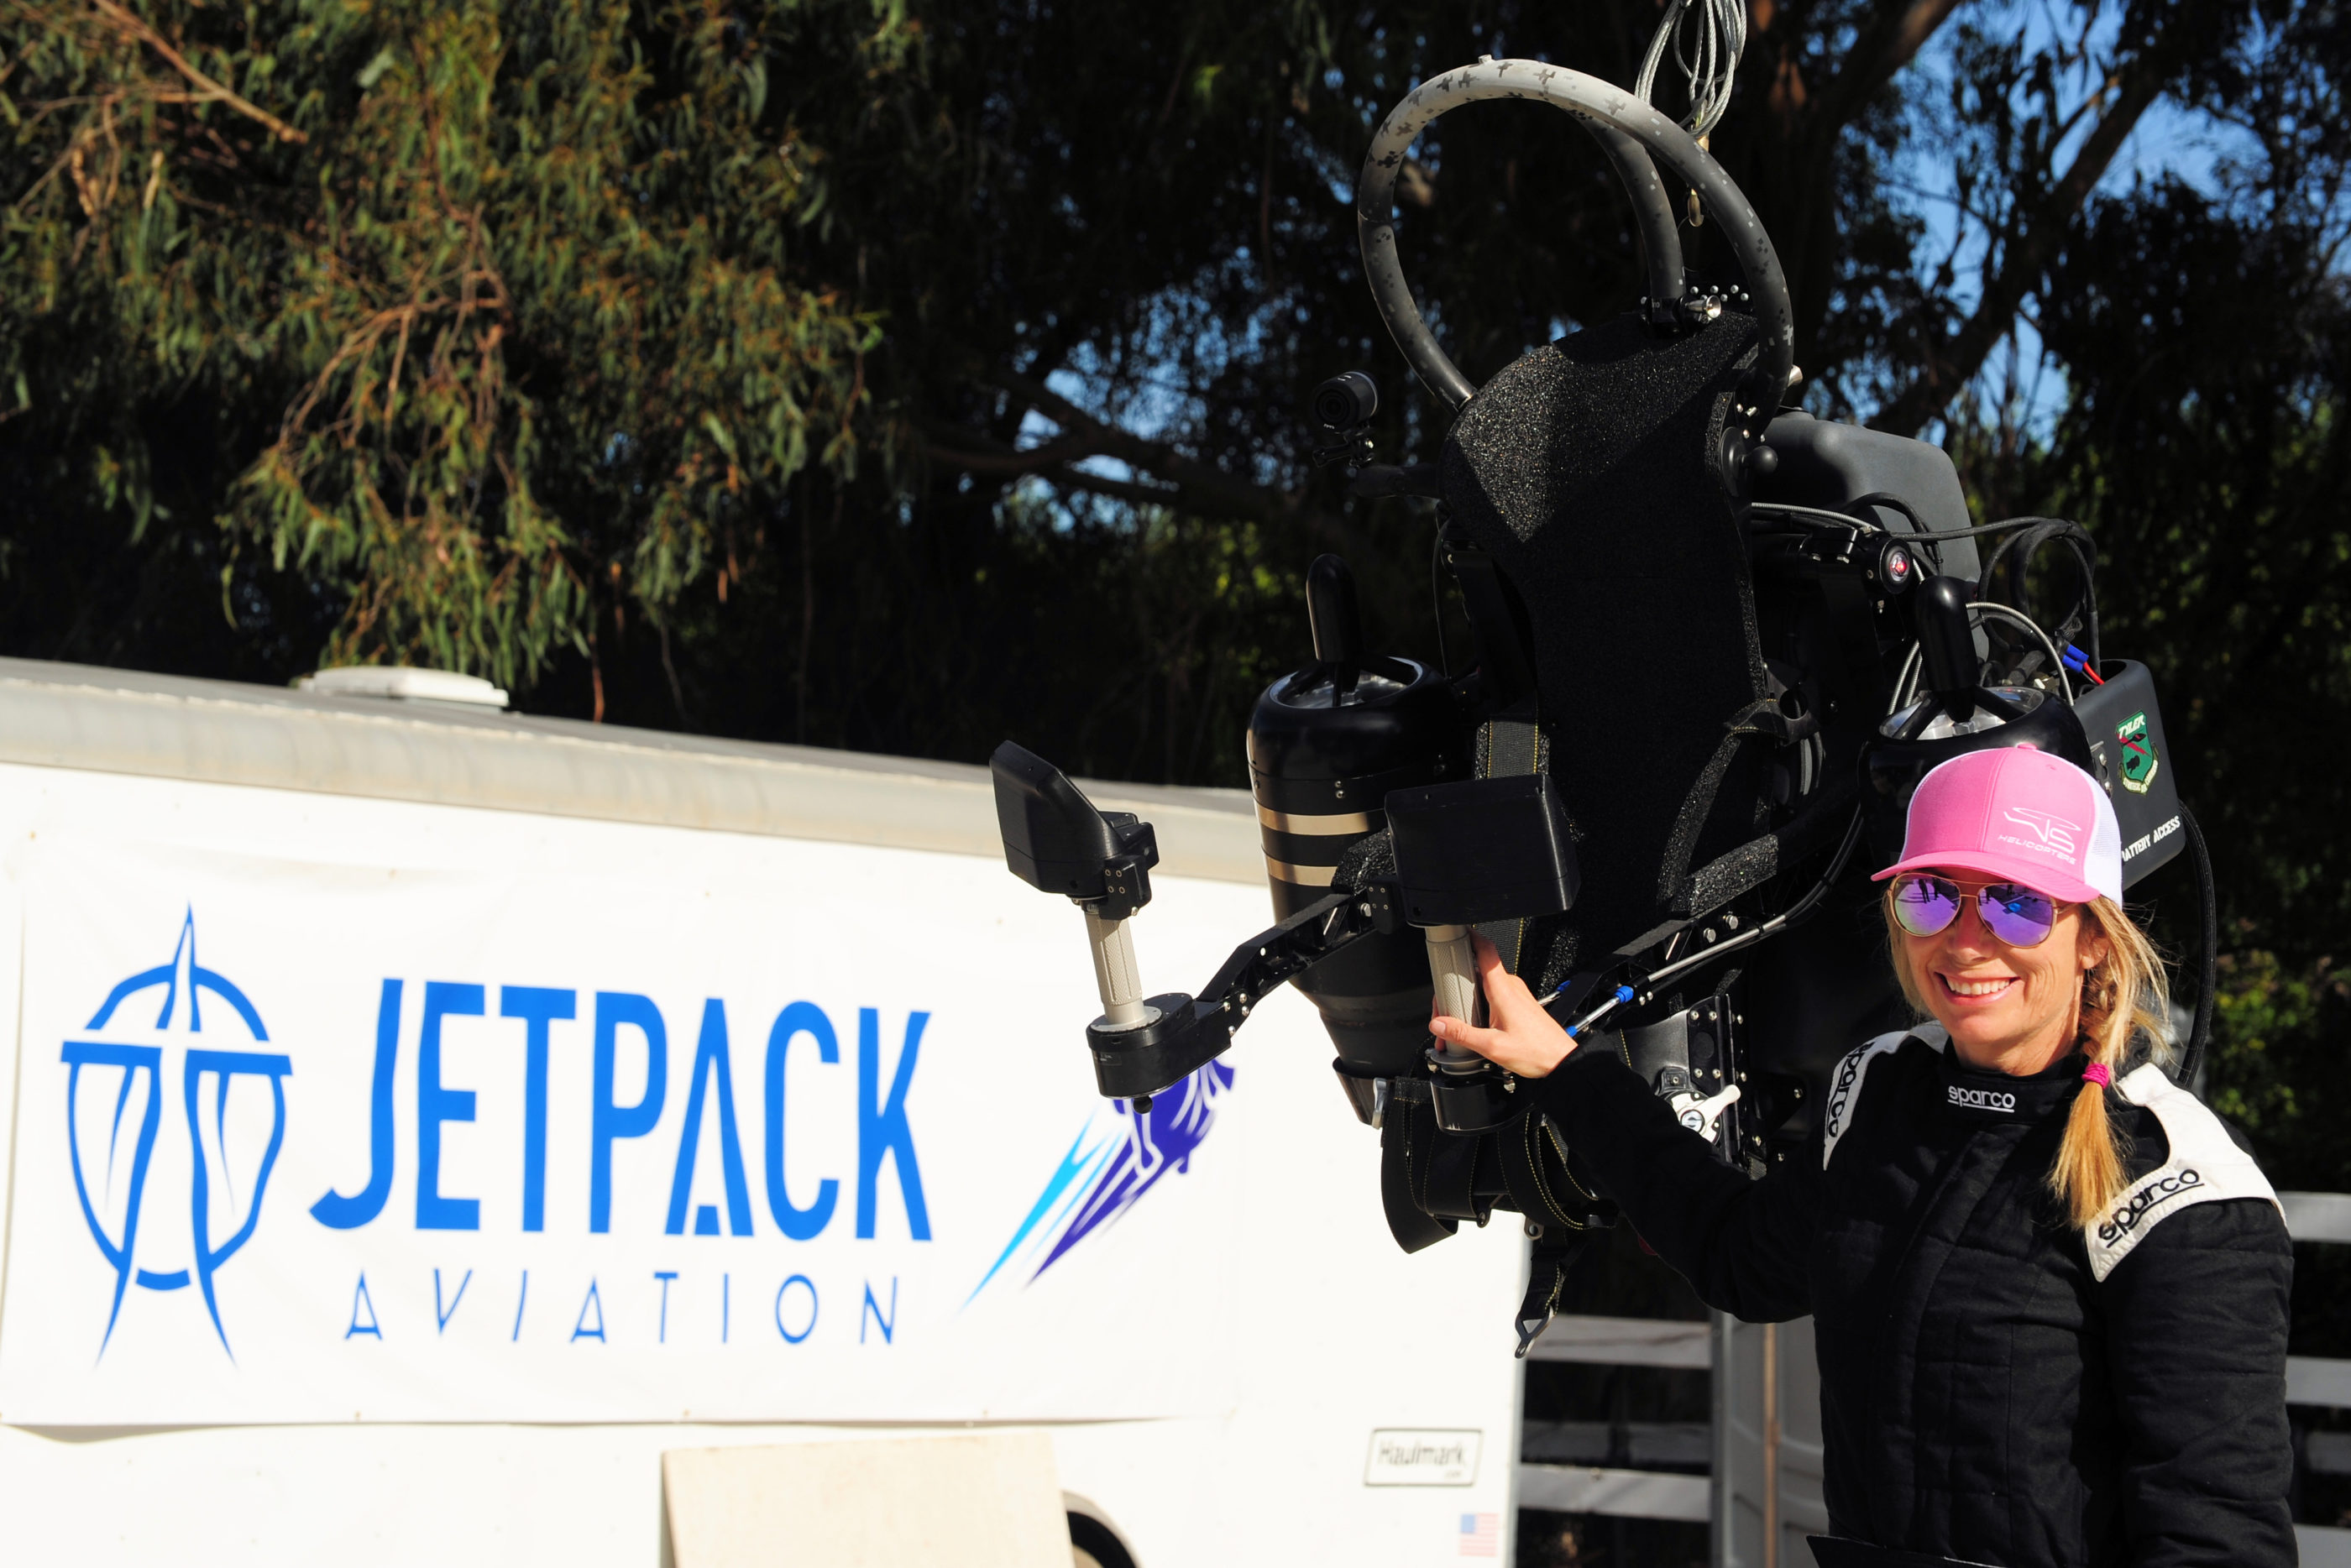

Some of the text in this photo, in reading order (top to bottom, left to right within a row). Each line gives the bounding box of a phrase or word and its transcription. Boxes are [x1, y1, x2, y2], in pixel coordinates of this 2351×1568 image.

[2118, 714, 2146, 740] TYLER
[2153, 815, 2181, 844] ACCESS
[1998, 834, 2076, 865] HELICOPTERS
[309, 978, 932, 1241] JETPACK
[1947, 1085, 2016, 1111] sparco
[2098, 1168, 2201, 1242] sparco
[345, 1267, 898, 1345] AVIATION
[1378, 1440, 1466, 1466] Haulmark
